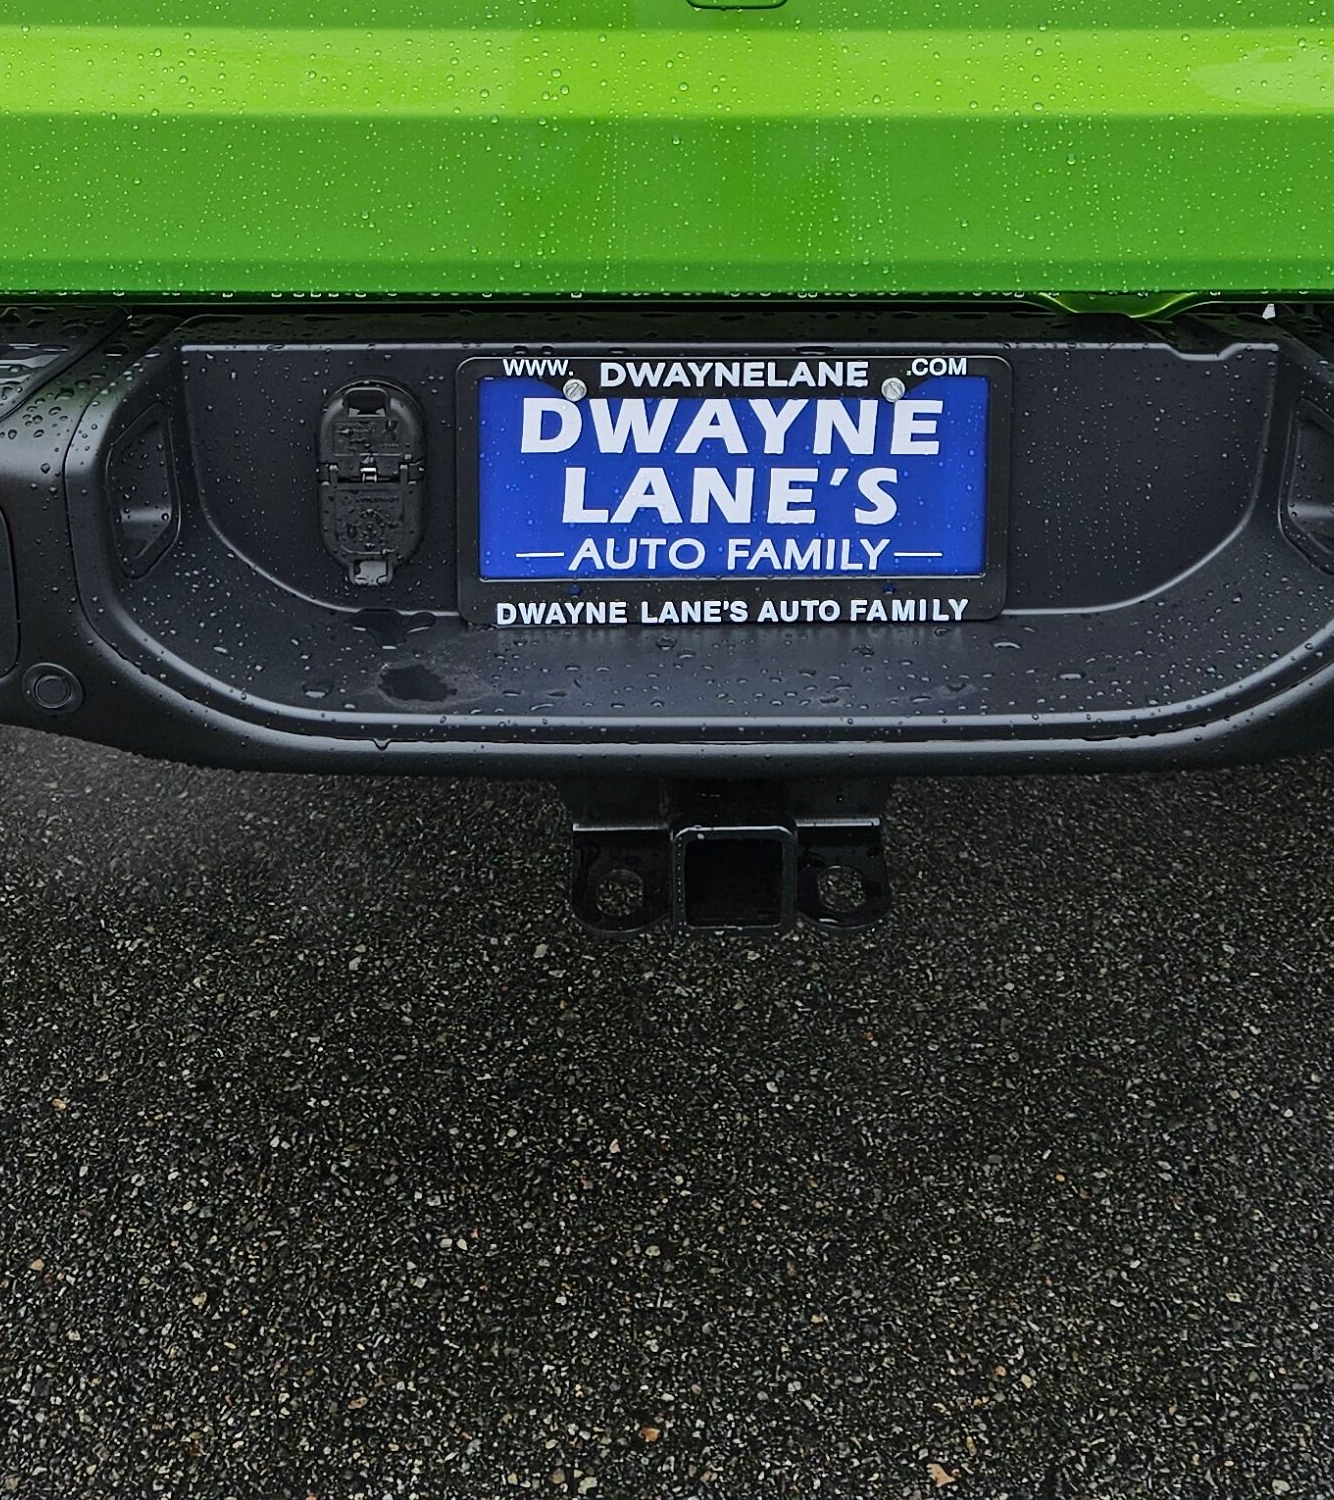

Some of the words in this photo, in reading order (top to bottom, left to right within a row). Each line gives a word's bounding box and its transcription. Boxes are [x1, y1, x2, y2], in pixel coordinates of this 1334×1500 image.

[502, 358, 574, 377] WWW.
[599, 361, 869, 388] DWAYNELANE
[905, 357, 967, 376] .COM
[520, 397, 943, 456] DWAYNE
[562, 467, 898, 525] LANE'S
[568, 537, 706, 571] AUTO
[727, 538, 891, 571] FAMILY
[496, 601, 628, 625] DWAYNE
[641, 599, 749, 624] LANE'S
[757, 599, 841, 622] AUTO
[849, 598, 969, 622] FAMILY
